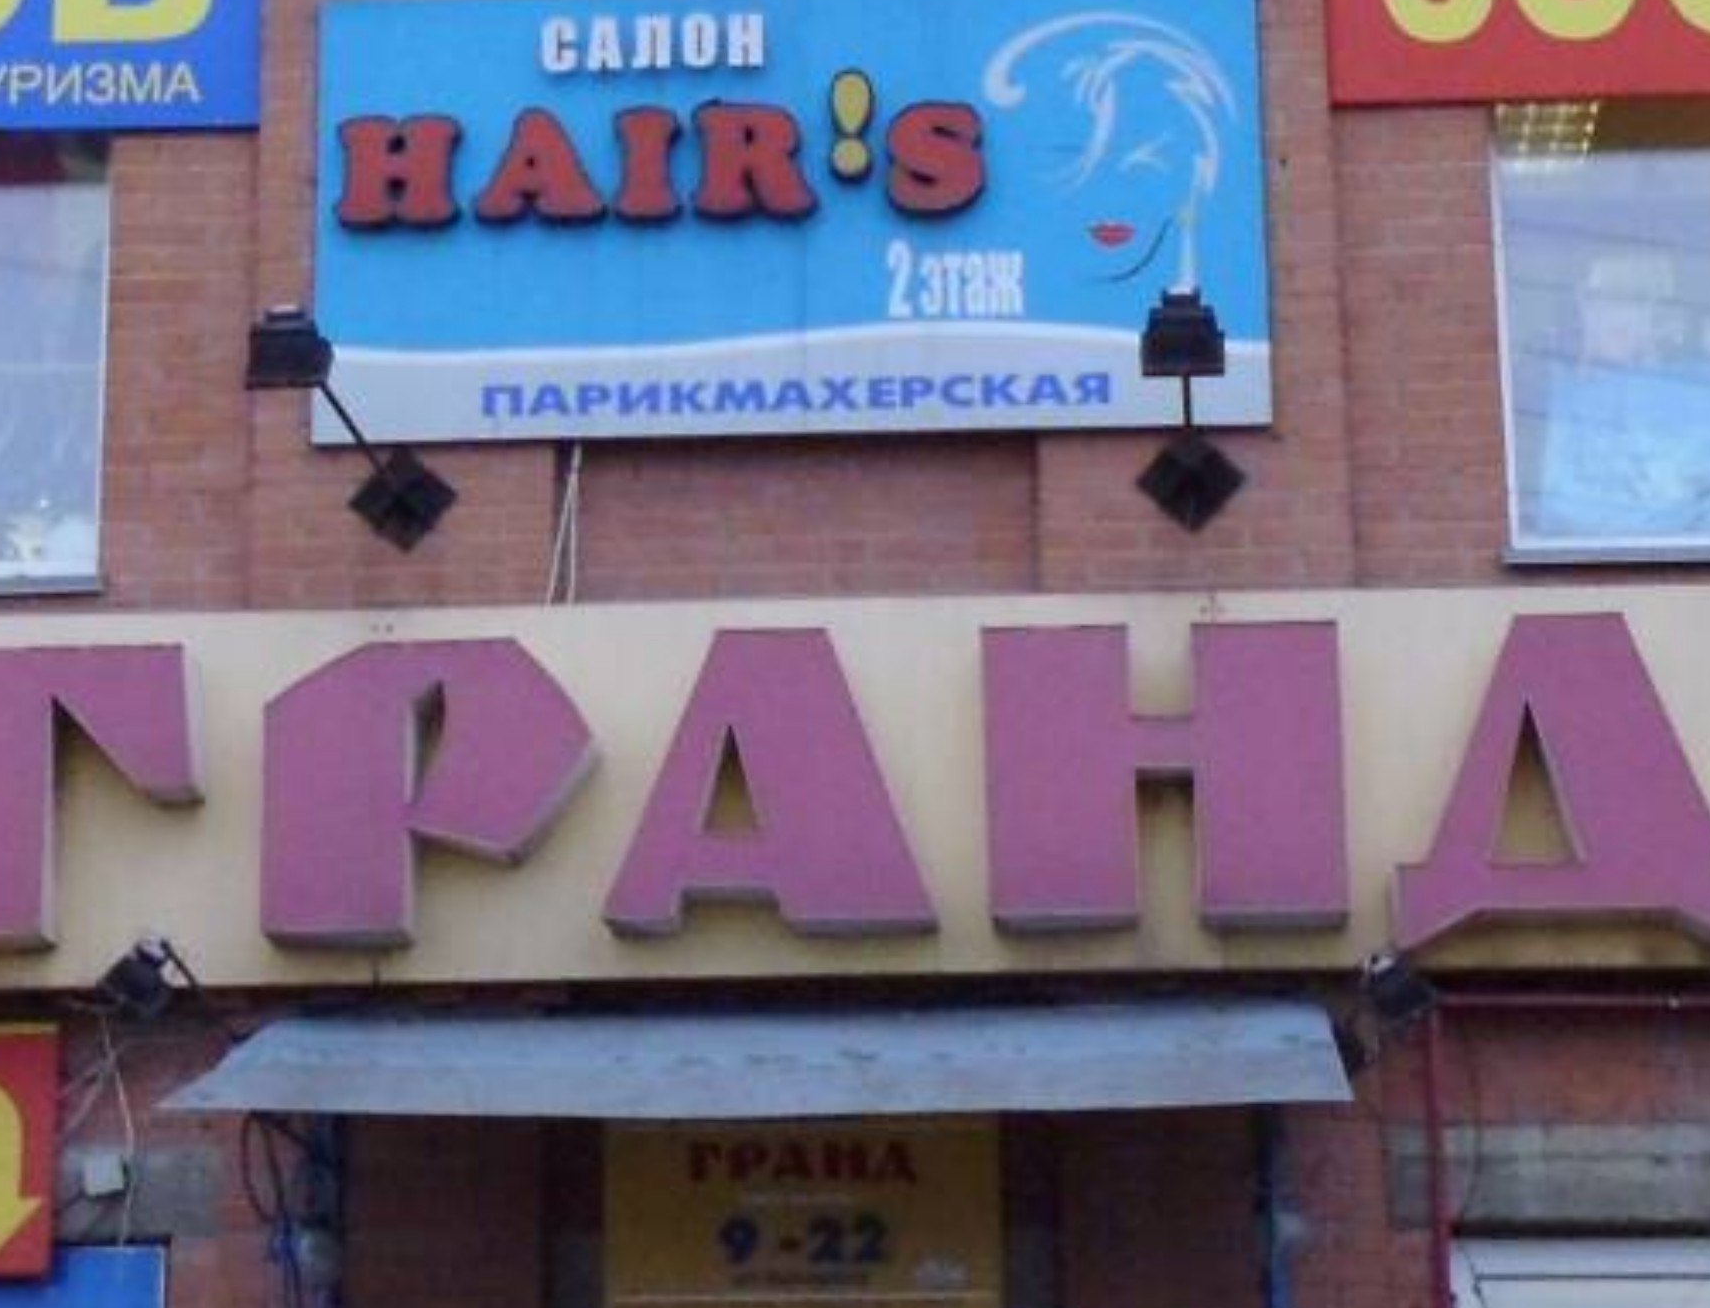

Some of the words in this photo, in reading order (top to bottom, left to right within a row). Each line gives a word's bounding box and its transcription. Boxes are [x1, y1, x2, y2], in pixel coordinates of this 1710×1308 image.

[539, 12, 766, 74] САЛОН
[886, 240, 911, 316] 2
[481, 372, 1112, 420] ПАРИКМАХЕРСКАЯ
